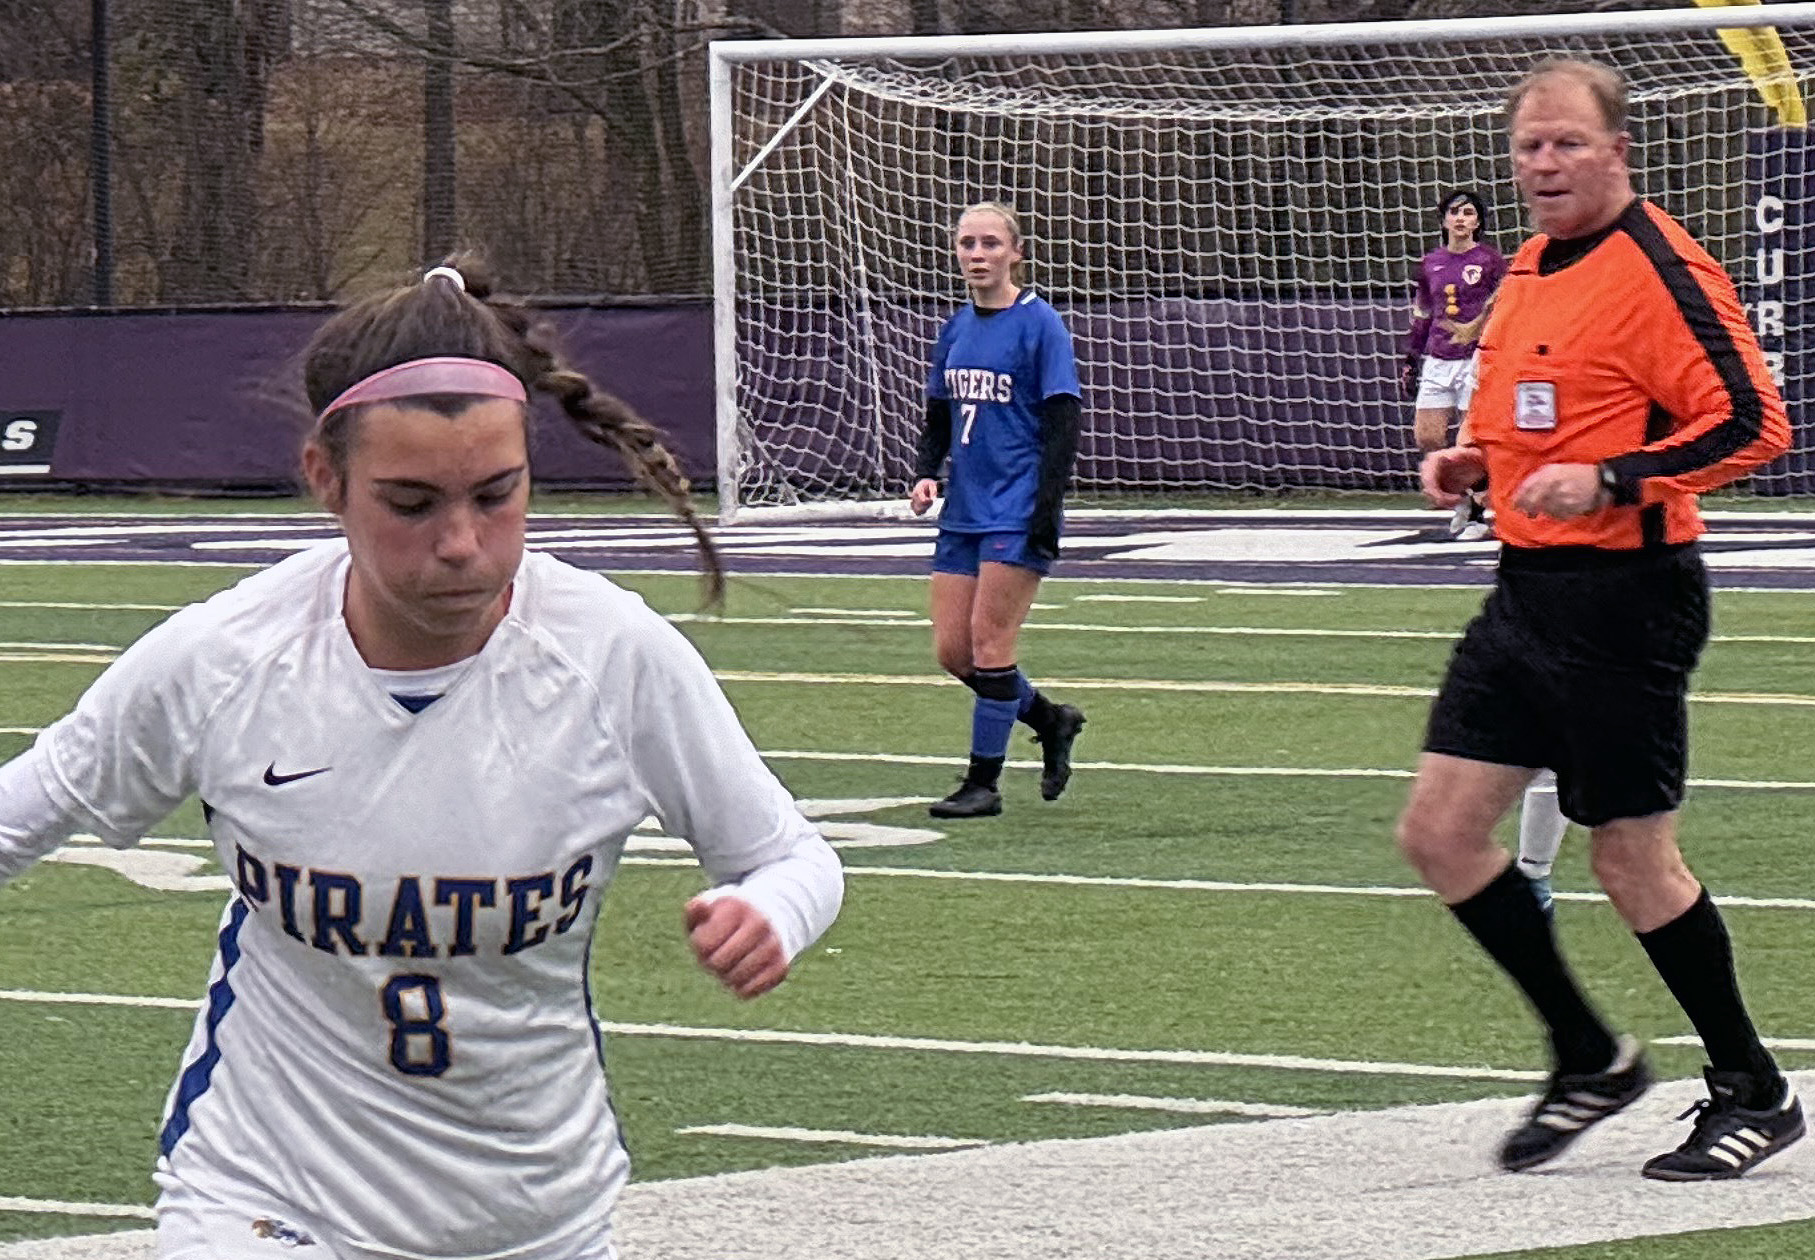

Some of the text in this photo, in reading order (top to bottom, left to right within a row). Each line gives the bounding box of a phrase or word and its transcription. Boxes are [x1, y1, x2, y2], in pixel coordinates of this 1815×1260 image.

[960, 403, 977, 446] 7
[235, 841, 595, 958] PIRATES
[382, 973, 454, 1078] 8
